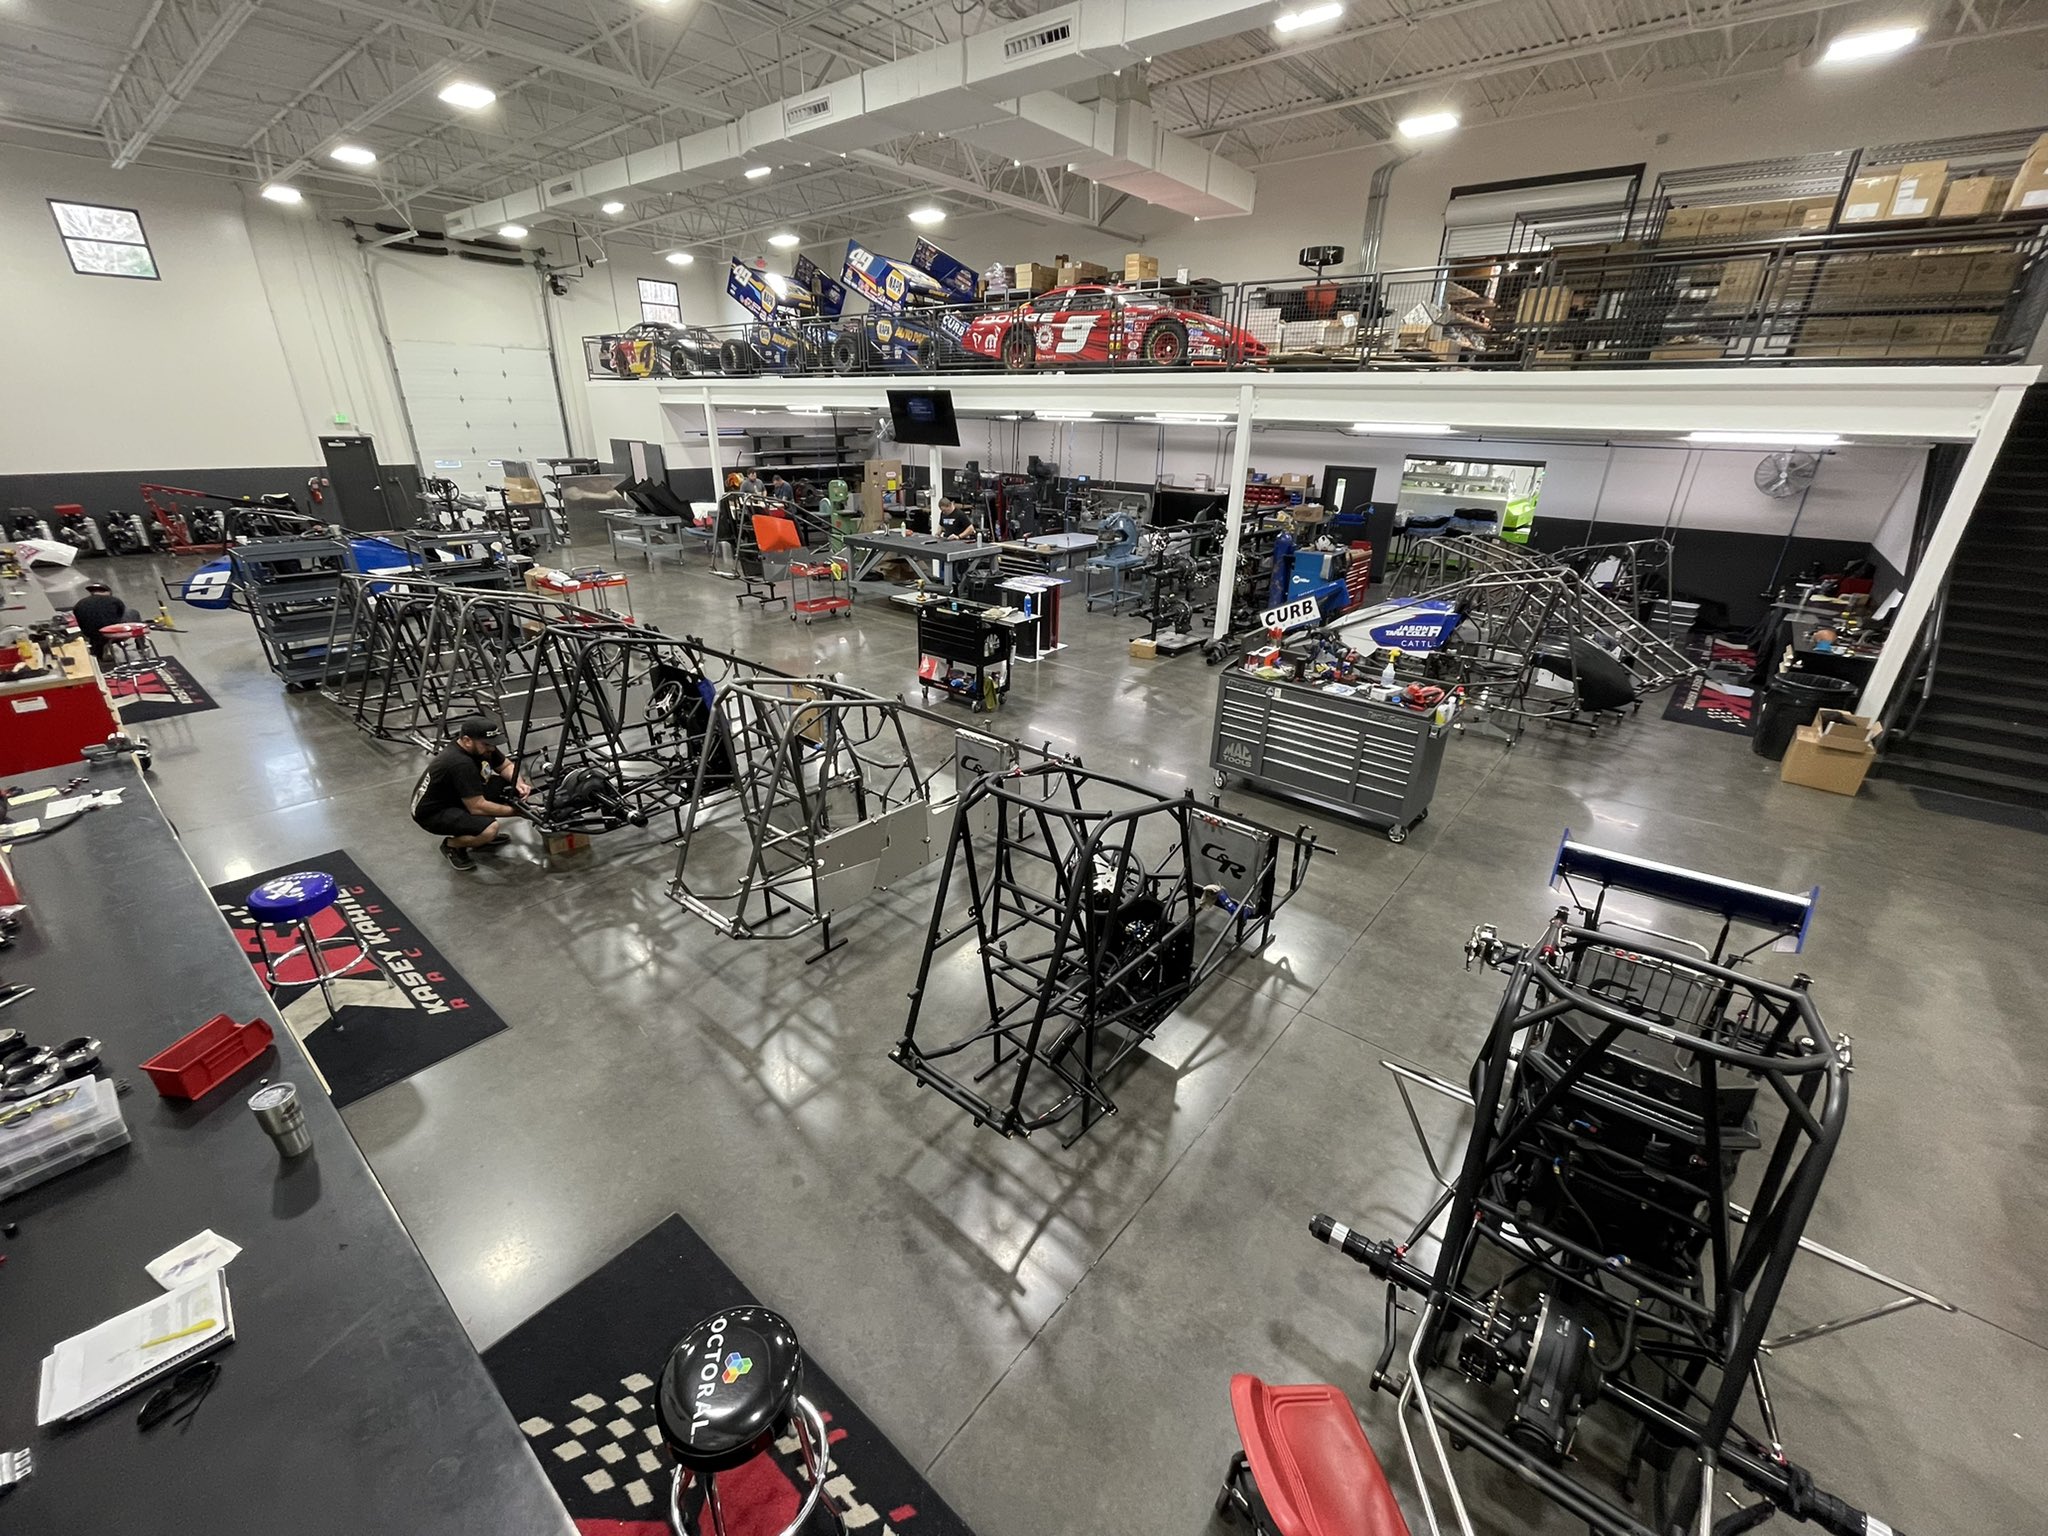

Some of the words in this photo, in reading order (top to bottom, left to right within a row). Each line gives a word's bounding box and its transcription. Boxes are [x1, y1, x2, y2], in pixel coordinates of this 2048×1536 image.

[848, 248, 874, 272] 49
[733, 264, 752, 287] 49
[942, 316, 966, 336] CURB
[1053, 315, 1101, 353] 9
[1265, 600, 1313, 627] CURB
[1223, 754, 1252, 768] TOOLS
[1224, 742, 1252, 761] MAC
[960, 755, 990, 777] C&
[1201, 843, 1246, 879] C&R
[350, 885, 470, 1010] RACING
[376, 950, 450, 1015] KASEY
[691, 1317, 727, 1444] OCTORAL
